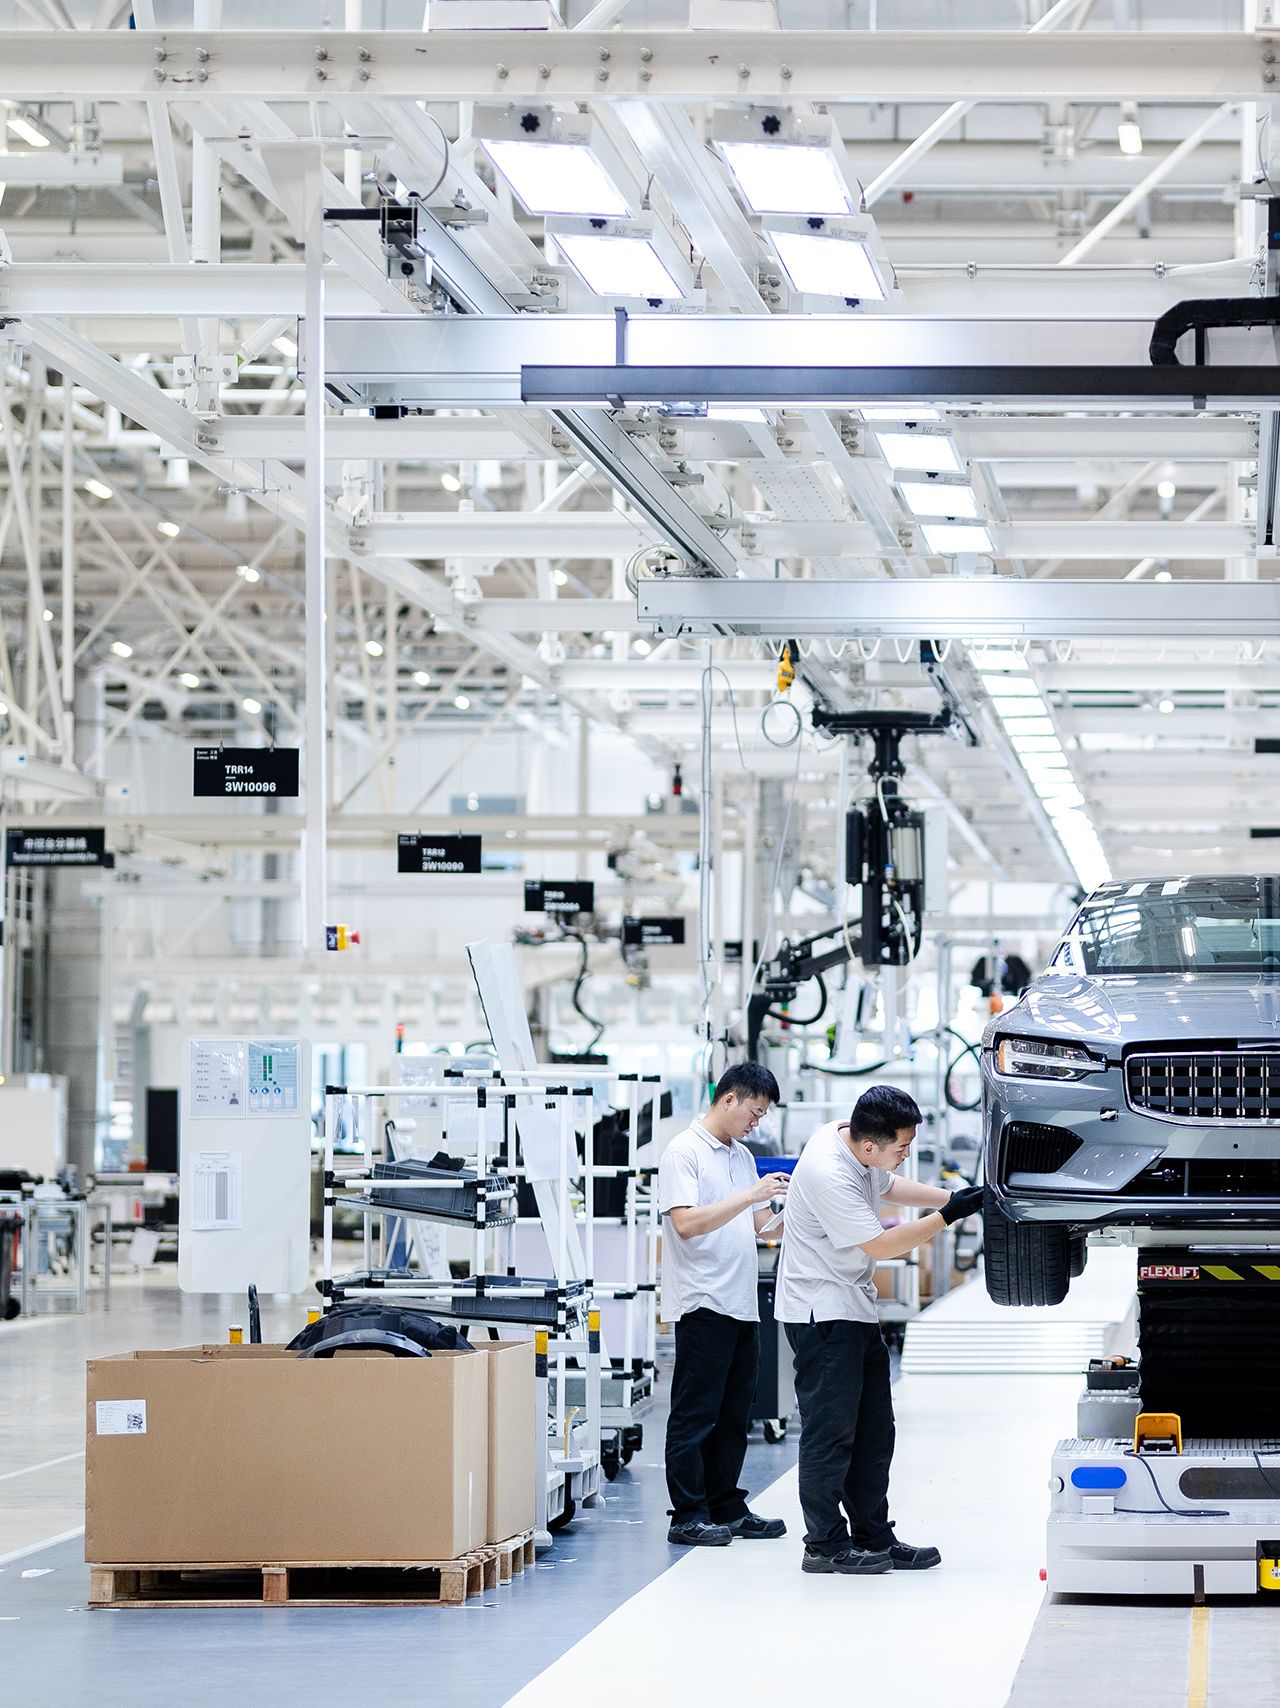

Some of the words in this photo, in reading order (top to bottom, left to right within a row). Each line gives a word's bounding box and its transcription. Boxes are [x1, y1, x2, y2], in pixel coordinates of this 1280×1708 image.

[224, 765, 254, 775] TRR14
[224, 781, 277, 793] 3W10096
[1140, 1266, 1199, 1278] FLEXLIFT
